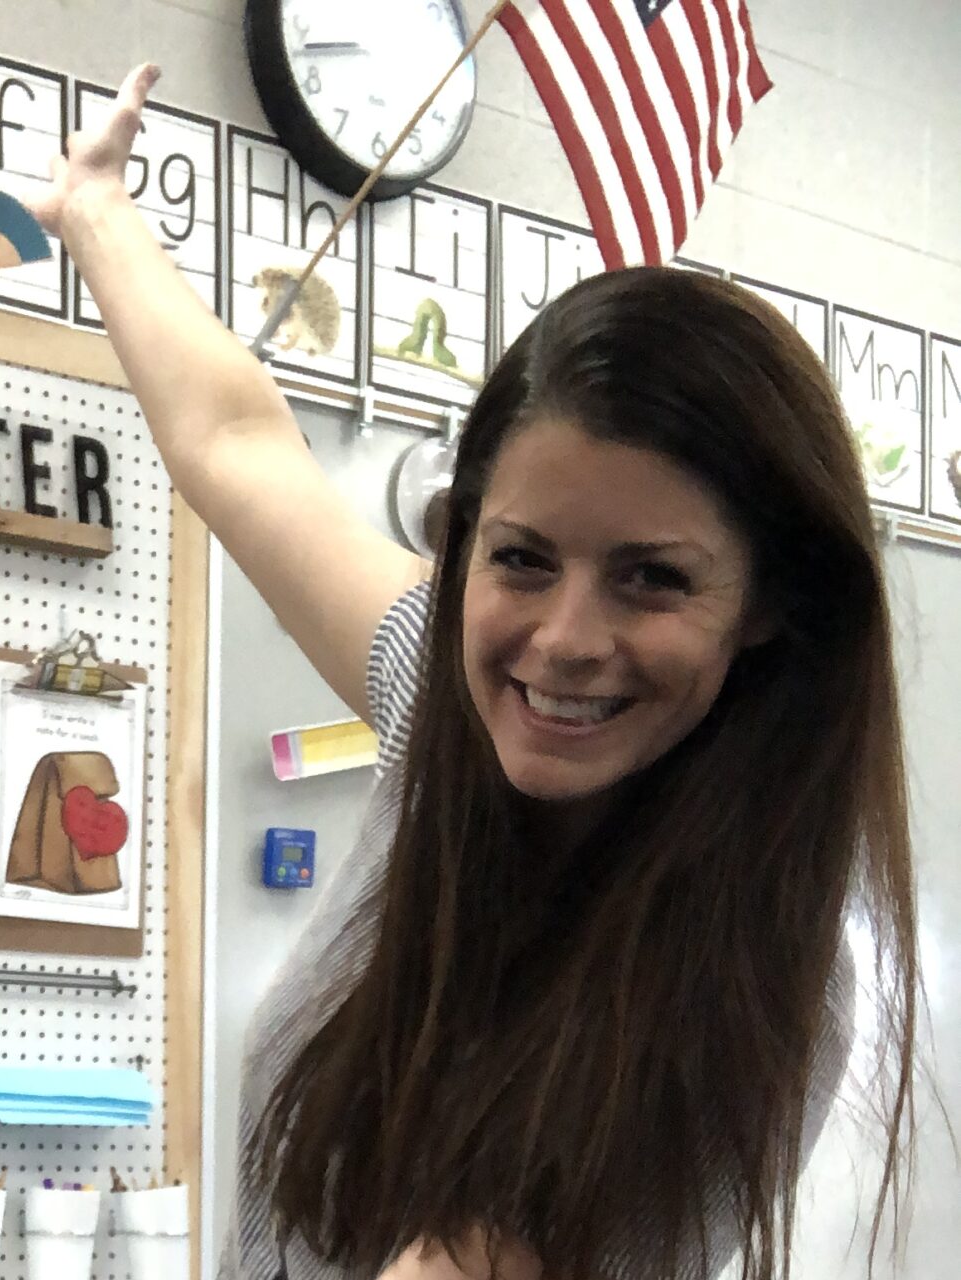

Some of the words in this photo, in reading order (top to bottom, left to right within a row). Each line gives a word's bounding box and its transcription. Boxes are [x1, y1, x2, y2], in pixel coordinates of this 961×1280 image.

[333, 106, 349, 141] 7
[370, 130, 388, 160] 6
[246, 146, 341, 258] Hh
[838, 320, 921, 412] Mm
